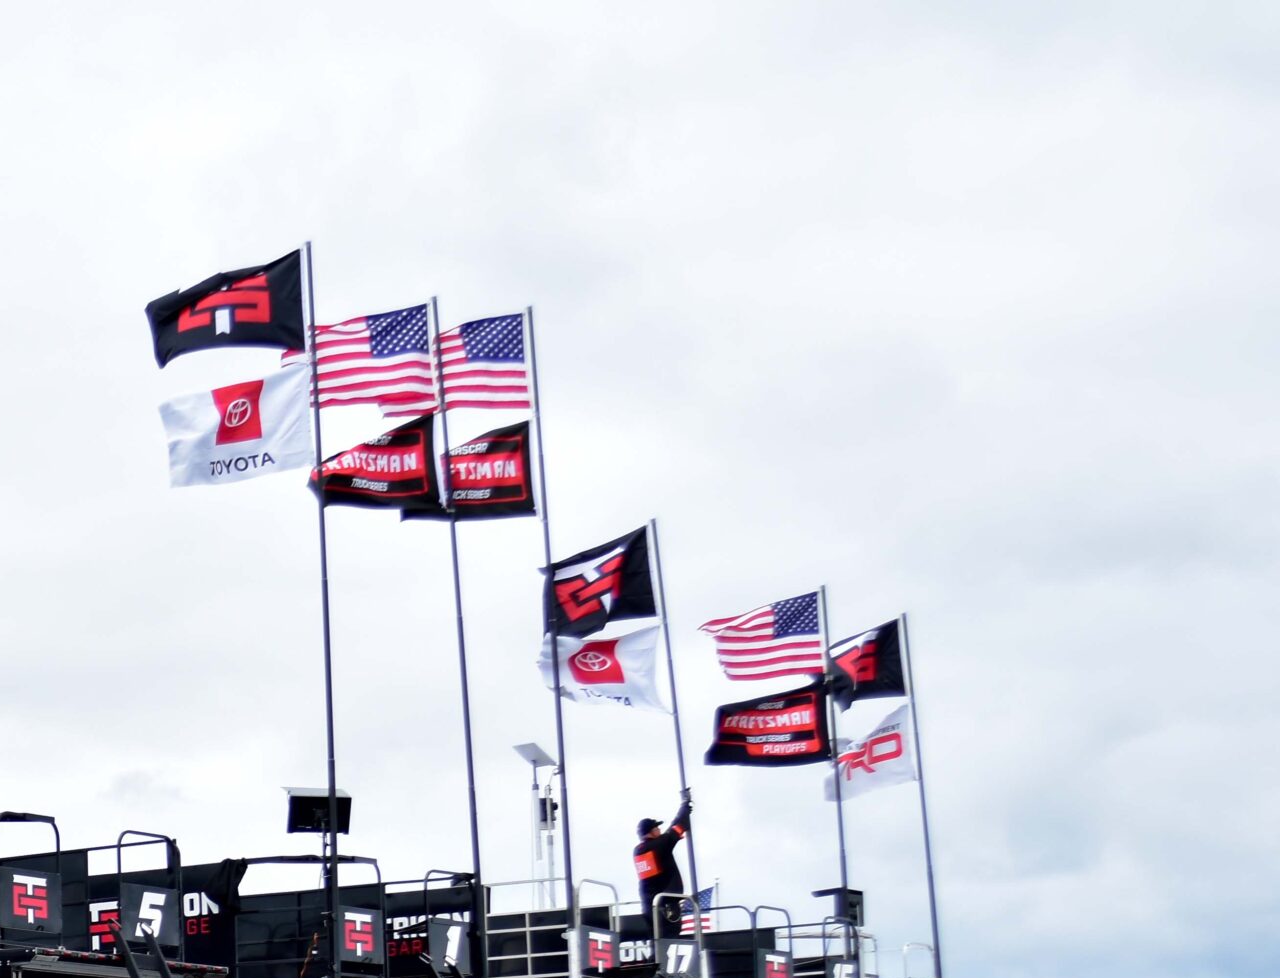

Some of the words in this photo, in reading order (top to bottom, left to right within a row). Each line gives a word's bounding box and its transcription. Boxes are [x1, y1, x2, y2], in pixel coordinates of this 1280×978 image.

[210, 452, 275, 476] TOYOTA
[724, 710, 810, 728] CRAFTSMAN
[762, 742, 806, 754] PLAYOFFS
[135, 891, 166, 937] 5
[444, 925, 462, 967] 1
[666, 944, 693, 974] 17
